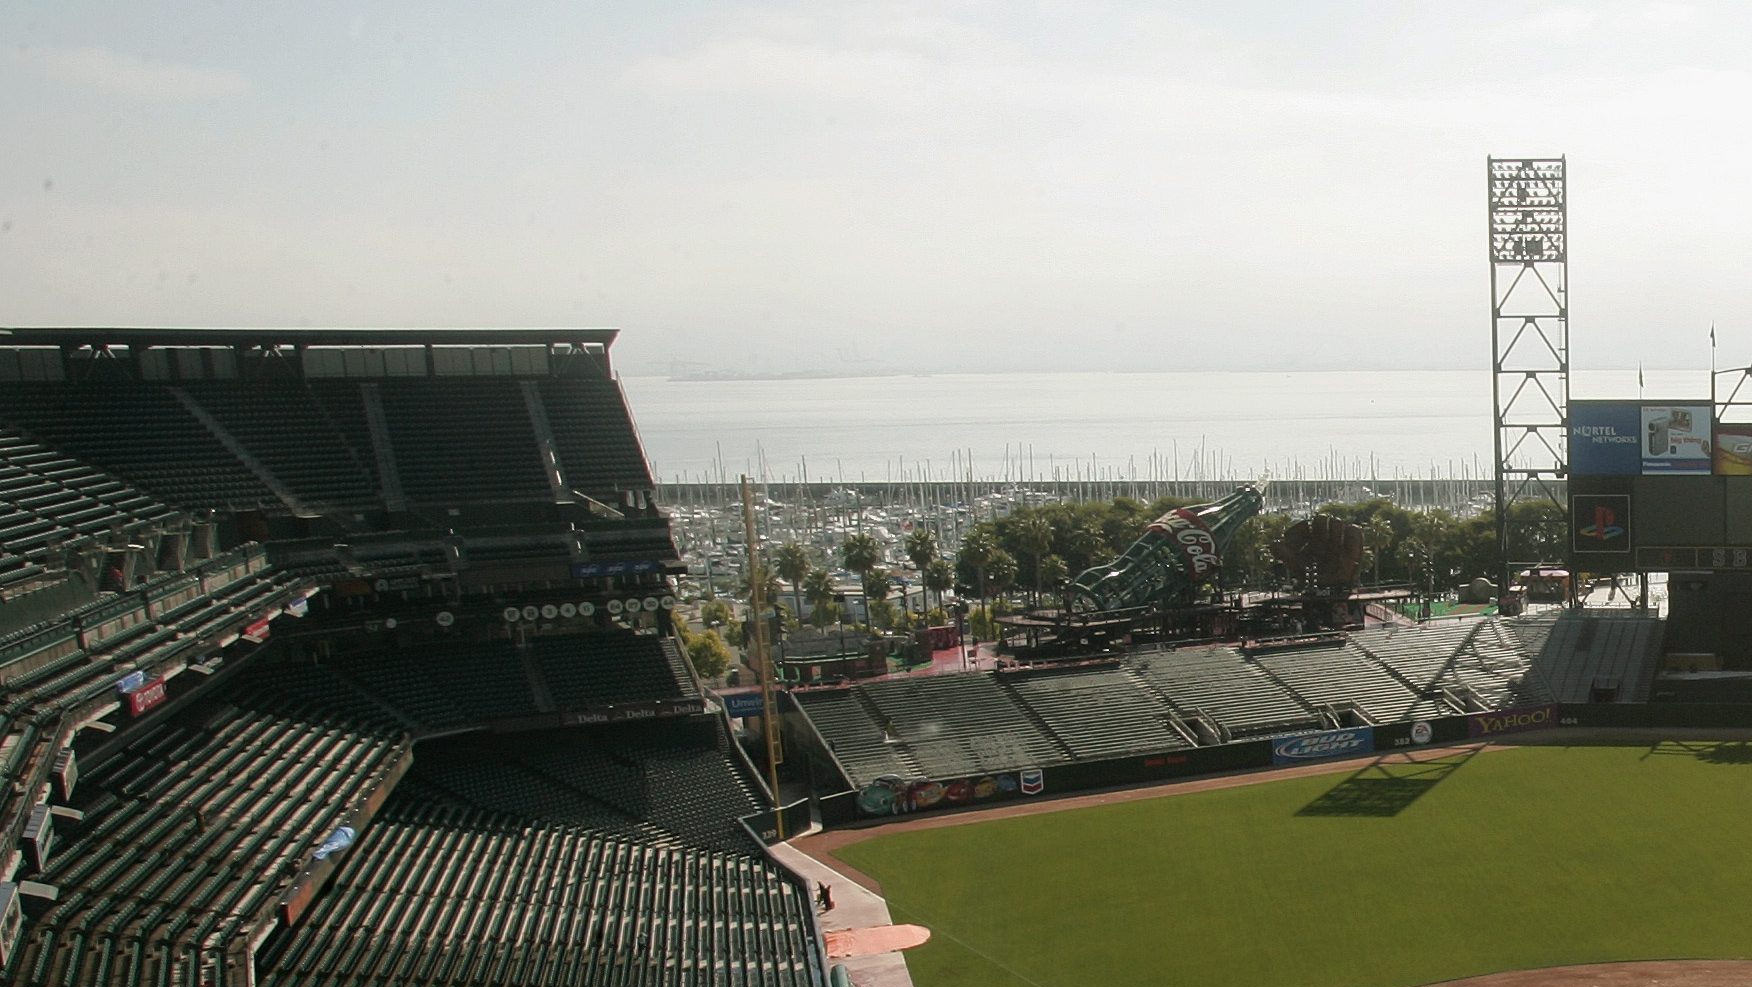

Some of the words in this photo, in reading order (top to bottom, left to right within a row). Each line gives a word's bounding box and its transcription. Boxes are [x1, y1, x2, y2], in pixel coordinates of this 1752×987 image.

[1573, 426, 1616, 437] NORTEL
[1592, 436, 1637, 444] NETWORKS
[626, 709, 656, 719] Delta
[673, 703, 703, 714] Delta
[578, 714, 608, 724] Delta
[1476, 708, 1551, 733] YAHOO!
[1301, 733, 1356, 746] BUD
[1290, 740, 1365, 755] LIGHT
